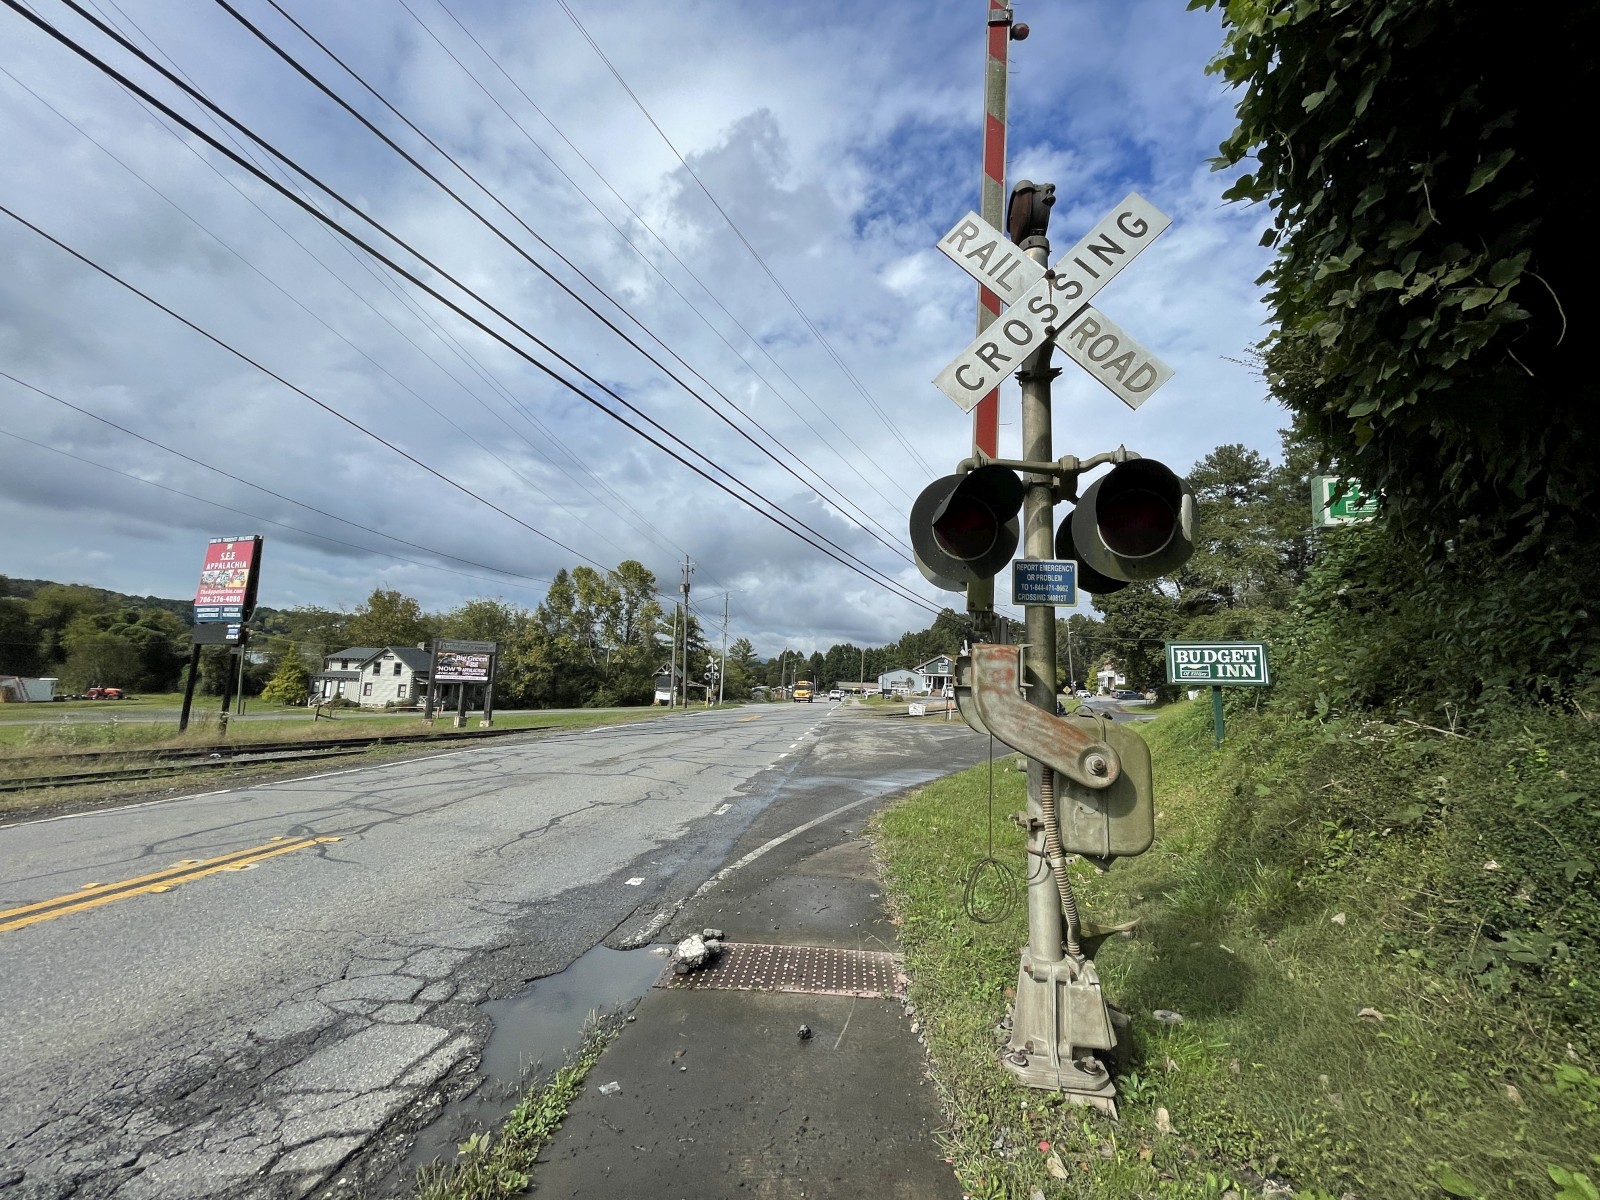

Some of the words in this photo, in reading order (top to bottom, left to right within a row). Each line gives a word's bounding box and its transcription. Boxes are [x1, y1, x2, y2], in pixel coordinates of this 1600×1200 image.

[946, 219, 1022, 292] RAIL
[1069, 316, 1158, 393] ROAD
[954, 211, 1149, 391] CROSSING
[206, 561, 247, 570] APPALACHIA
[1040, 564, 1073, 572] EMERGENCY
[1036, 574, 1063, 582] PROBLEM
[1017, 593, 1046, 601] CROSSING
[1175, 649, 1257, 663] BUDGET
[1216, 664, 1257, 677] INN
